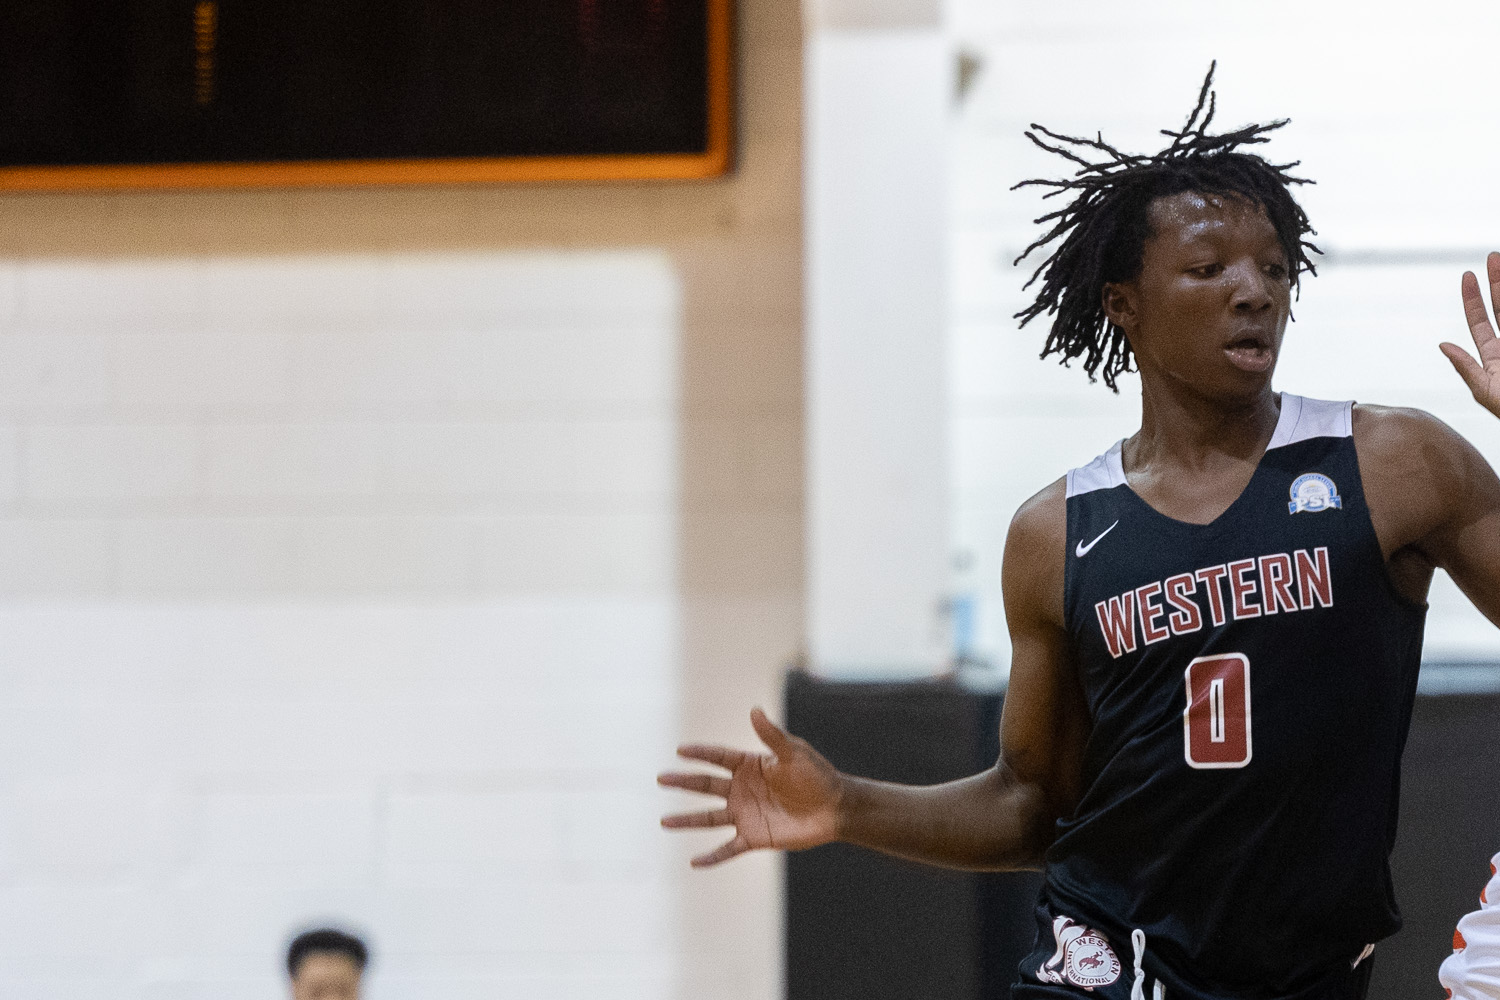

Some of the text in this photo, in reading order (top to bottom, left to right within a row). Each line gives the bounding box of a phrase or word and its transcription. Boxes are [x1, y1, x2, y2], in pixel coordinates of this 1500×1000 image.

[1094, 547, 1334, 659] WESTERN
[1184, 652, 1253, 769] 0
[1067, 950, 1111, 985] INTERNATIONAL
[1076, 937, 1120, 976] WESTERN
